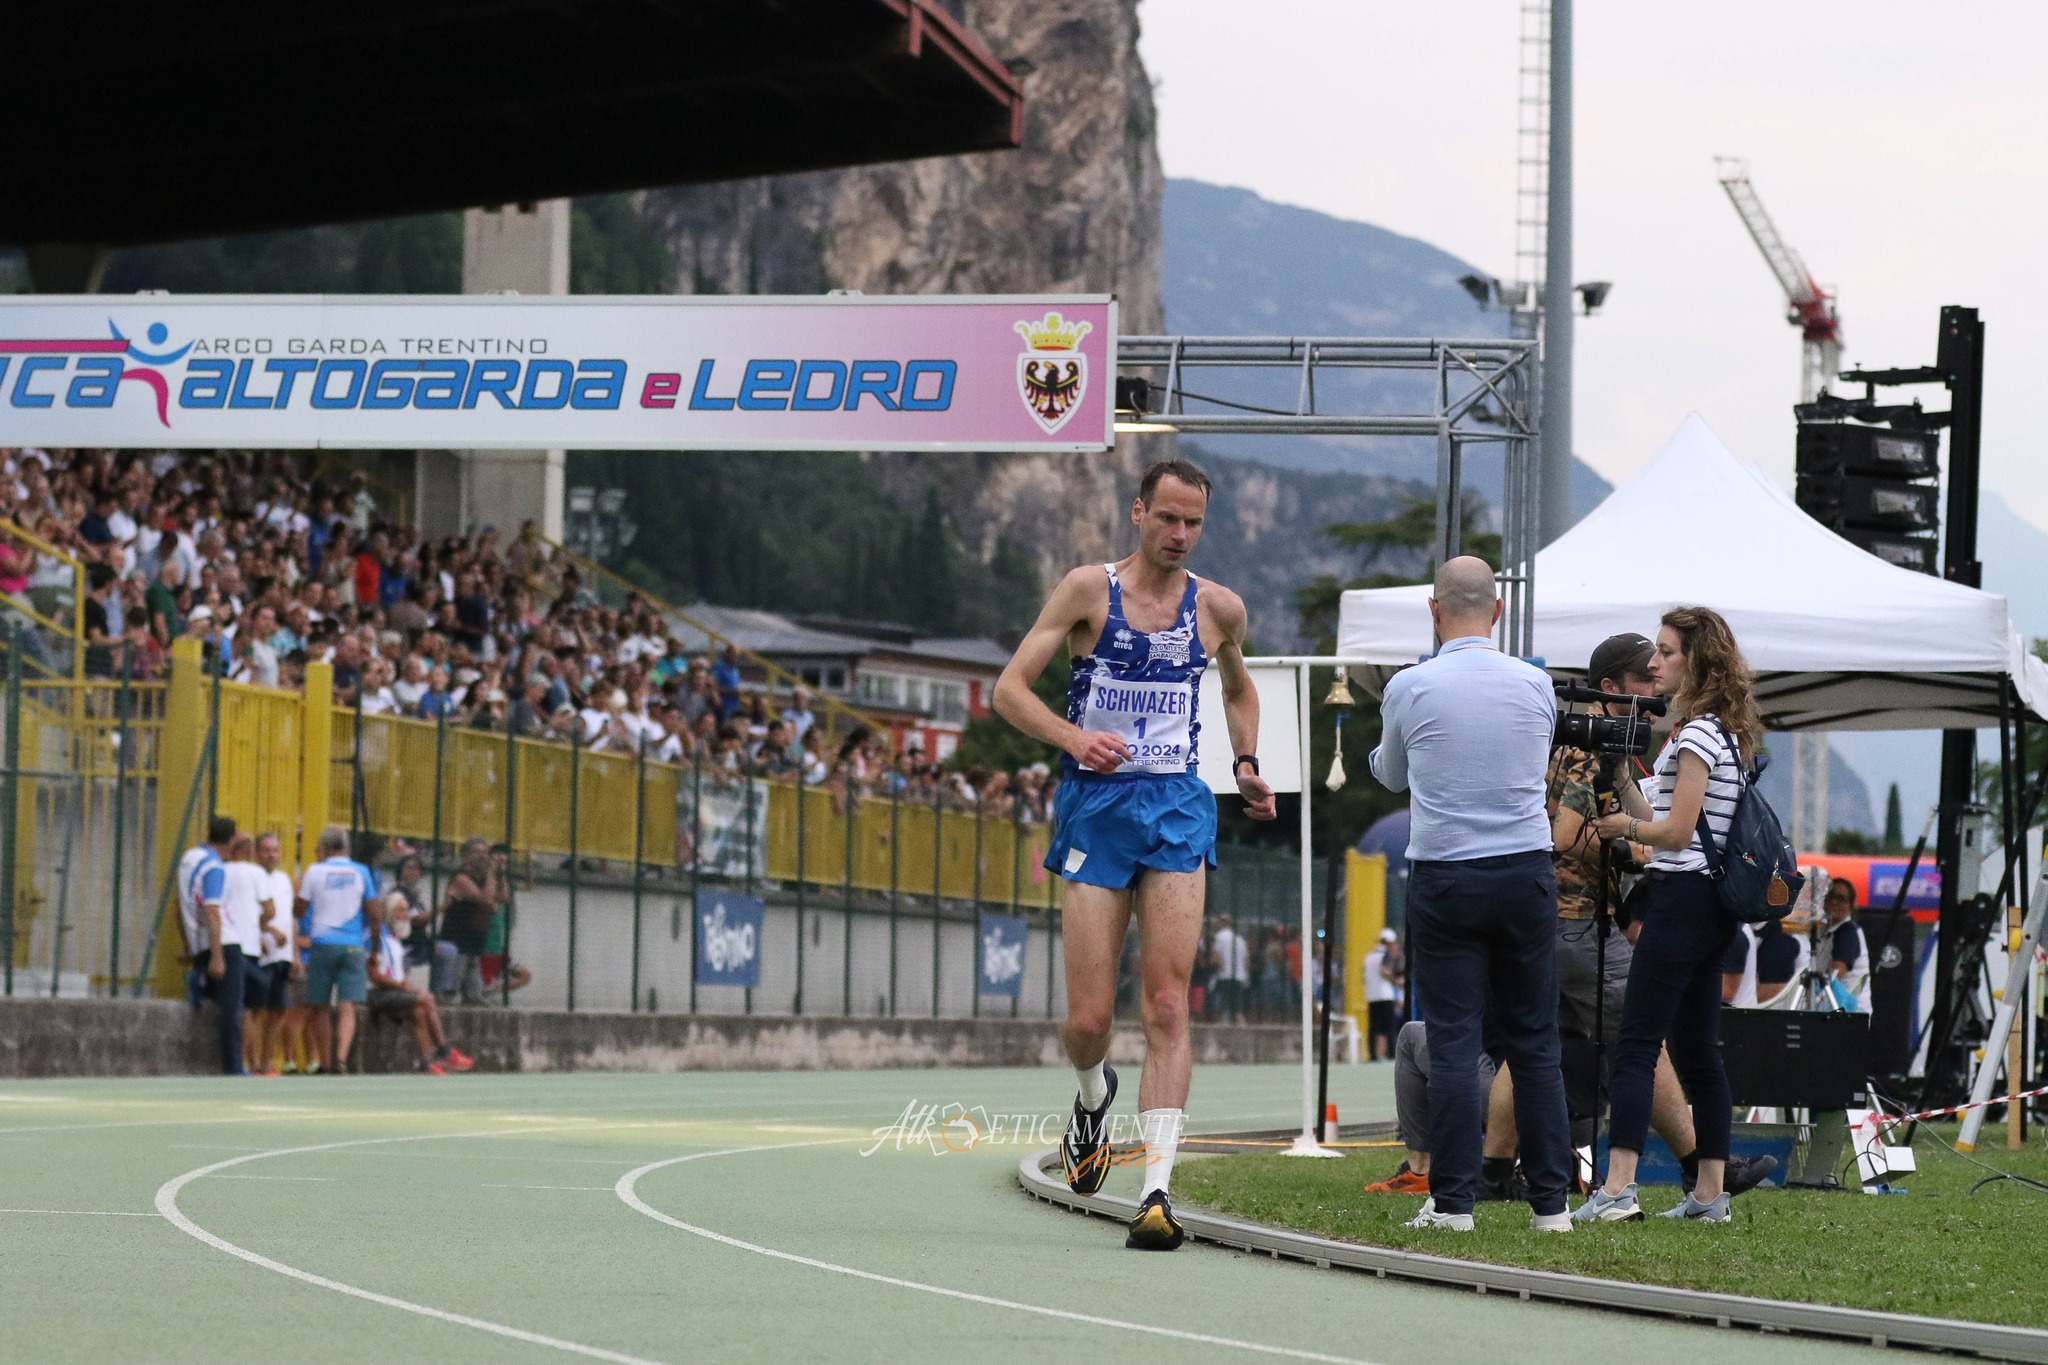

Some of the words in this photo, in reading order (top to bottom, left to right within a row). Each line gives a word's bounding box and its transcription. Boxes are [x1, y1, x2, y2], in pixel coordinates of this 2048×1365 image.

[193, 338, 273, 354] ARCO
[287, 338, 387, 354] GARDA
[400, 339, 549, 354] TRENTINO
[640, 372, 682, 409] e
[1095, 686, 1187, 715] SCHWAZER
[1133, 717, 1147, 739] 1
[1141, 744, 1180, 757] 2024
